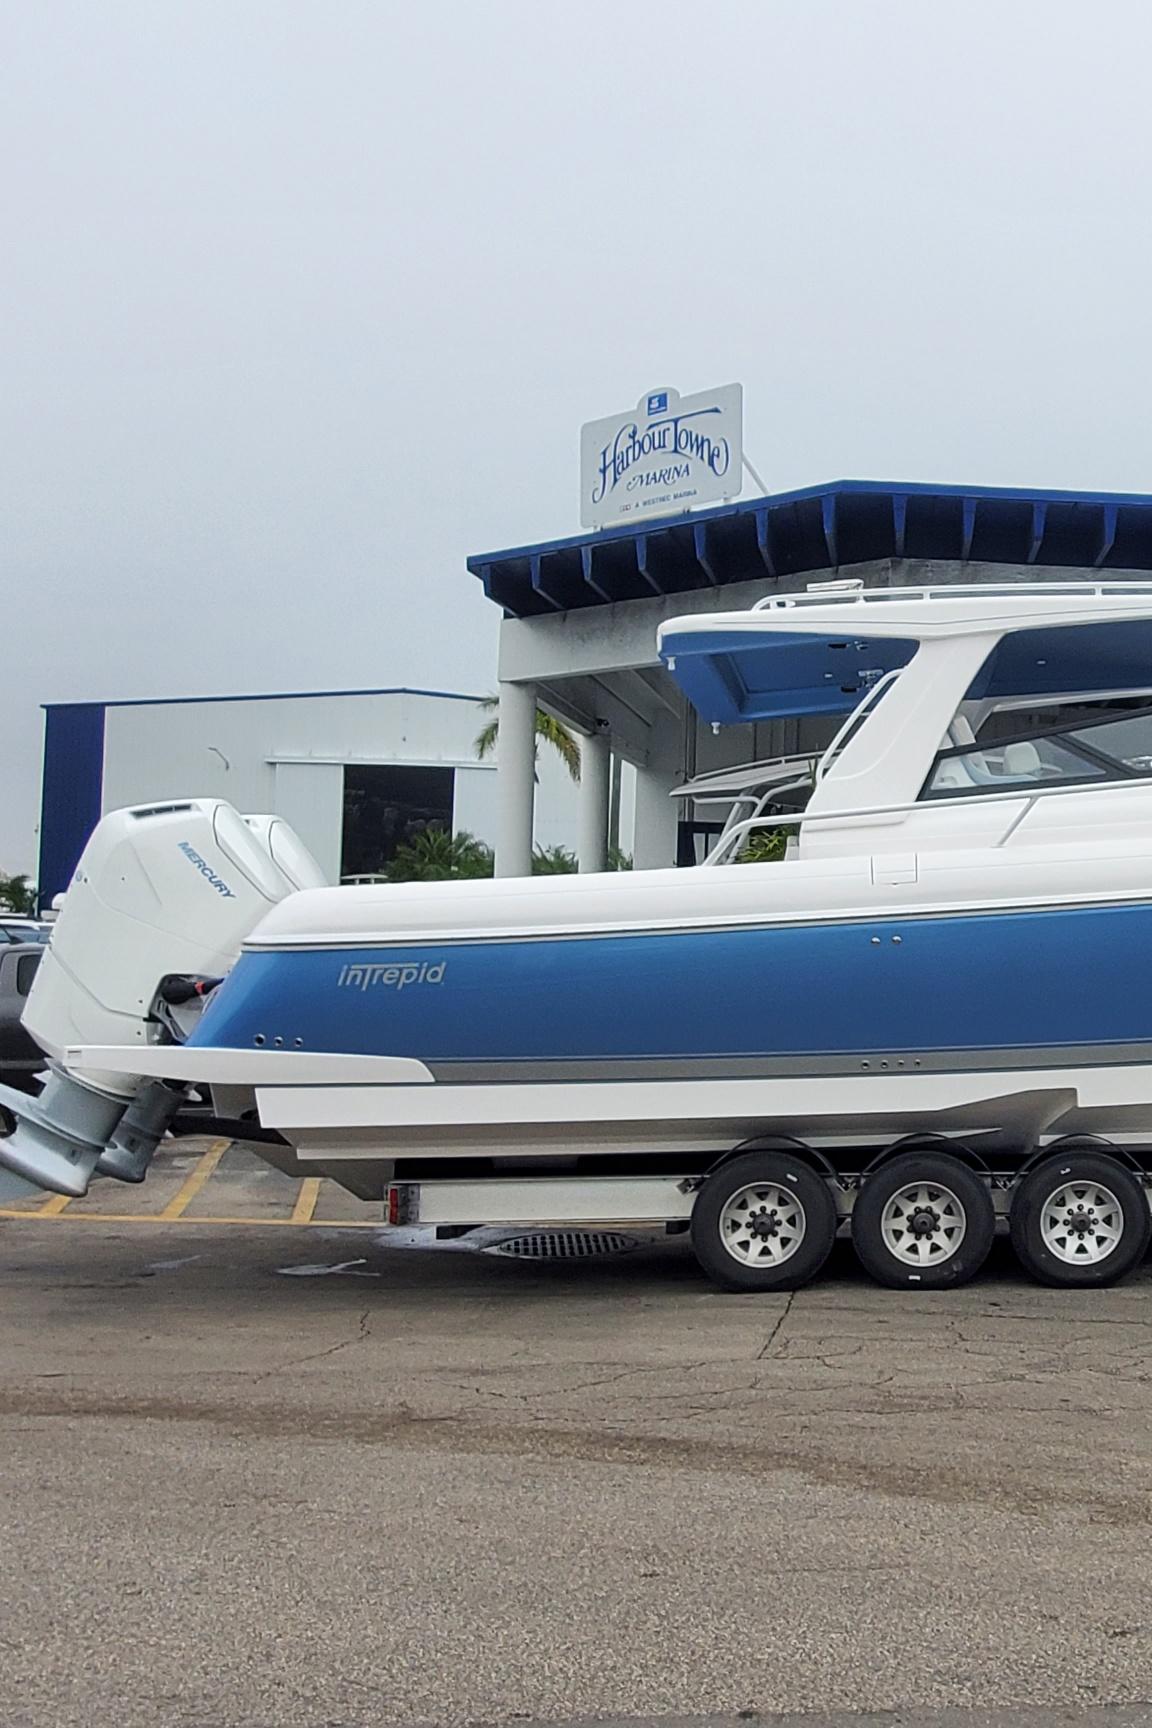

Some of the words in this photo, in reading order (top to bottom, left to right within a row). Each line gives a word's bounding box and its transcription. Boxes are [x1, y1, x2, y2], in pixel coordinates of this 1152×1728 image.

[592, 423, 671, 503] Harbour
[647, 407, 729, 476] Towne
[626, 463, 690, 491] MARINA
[177, 842, 236, 898] MERCURY
